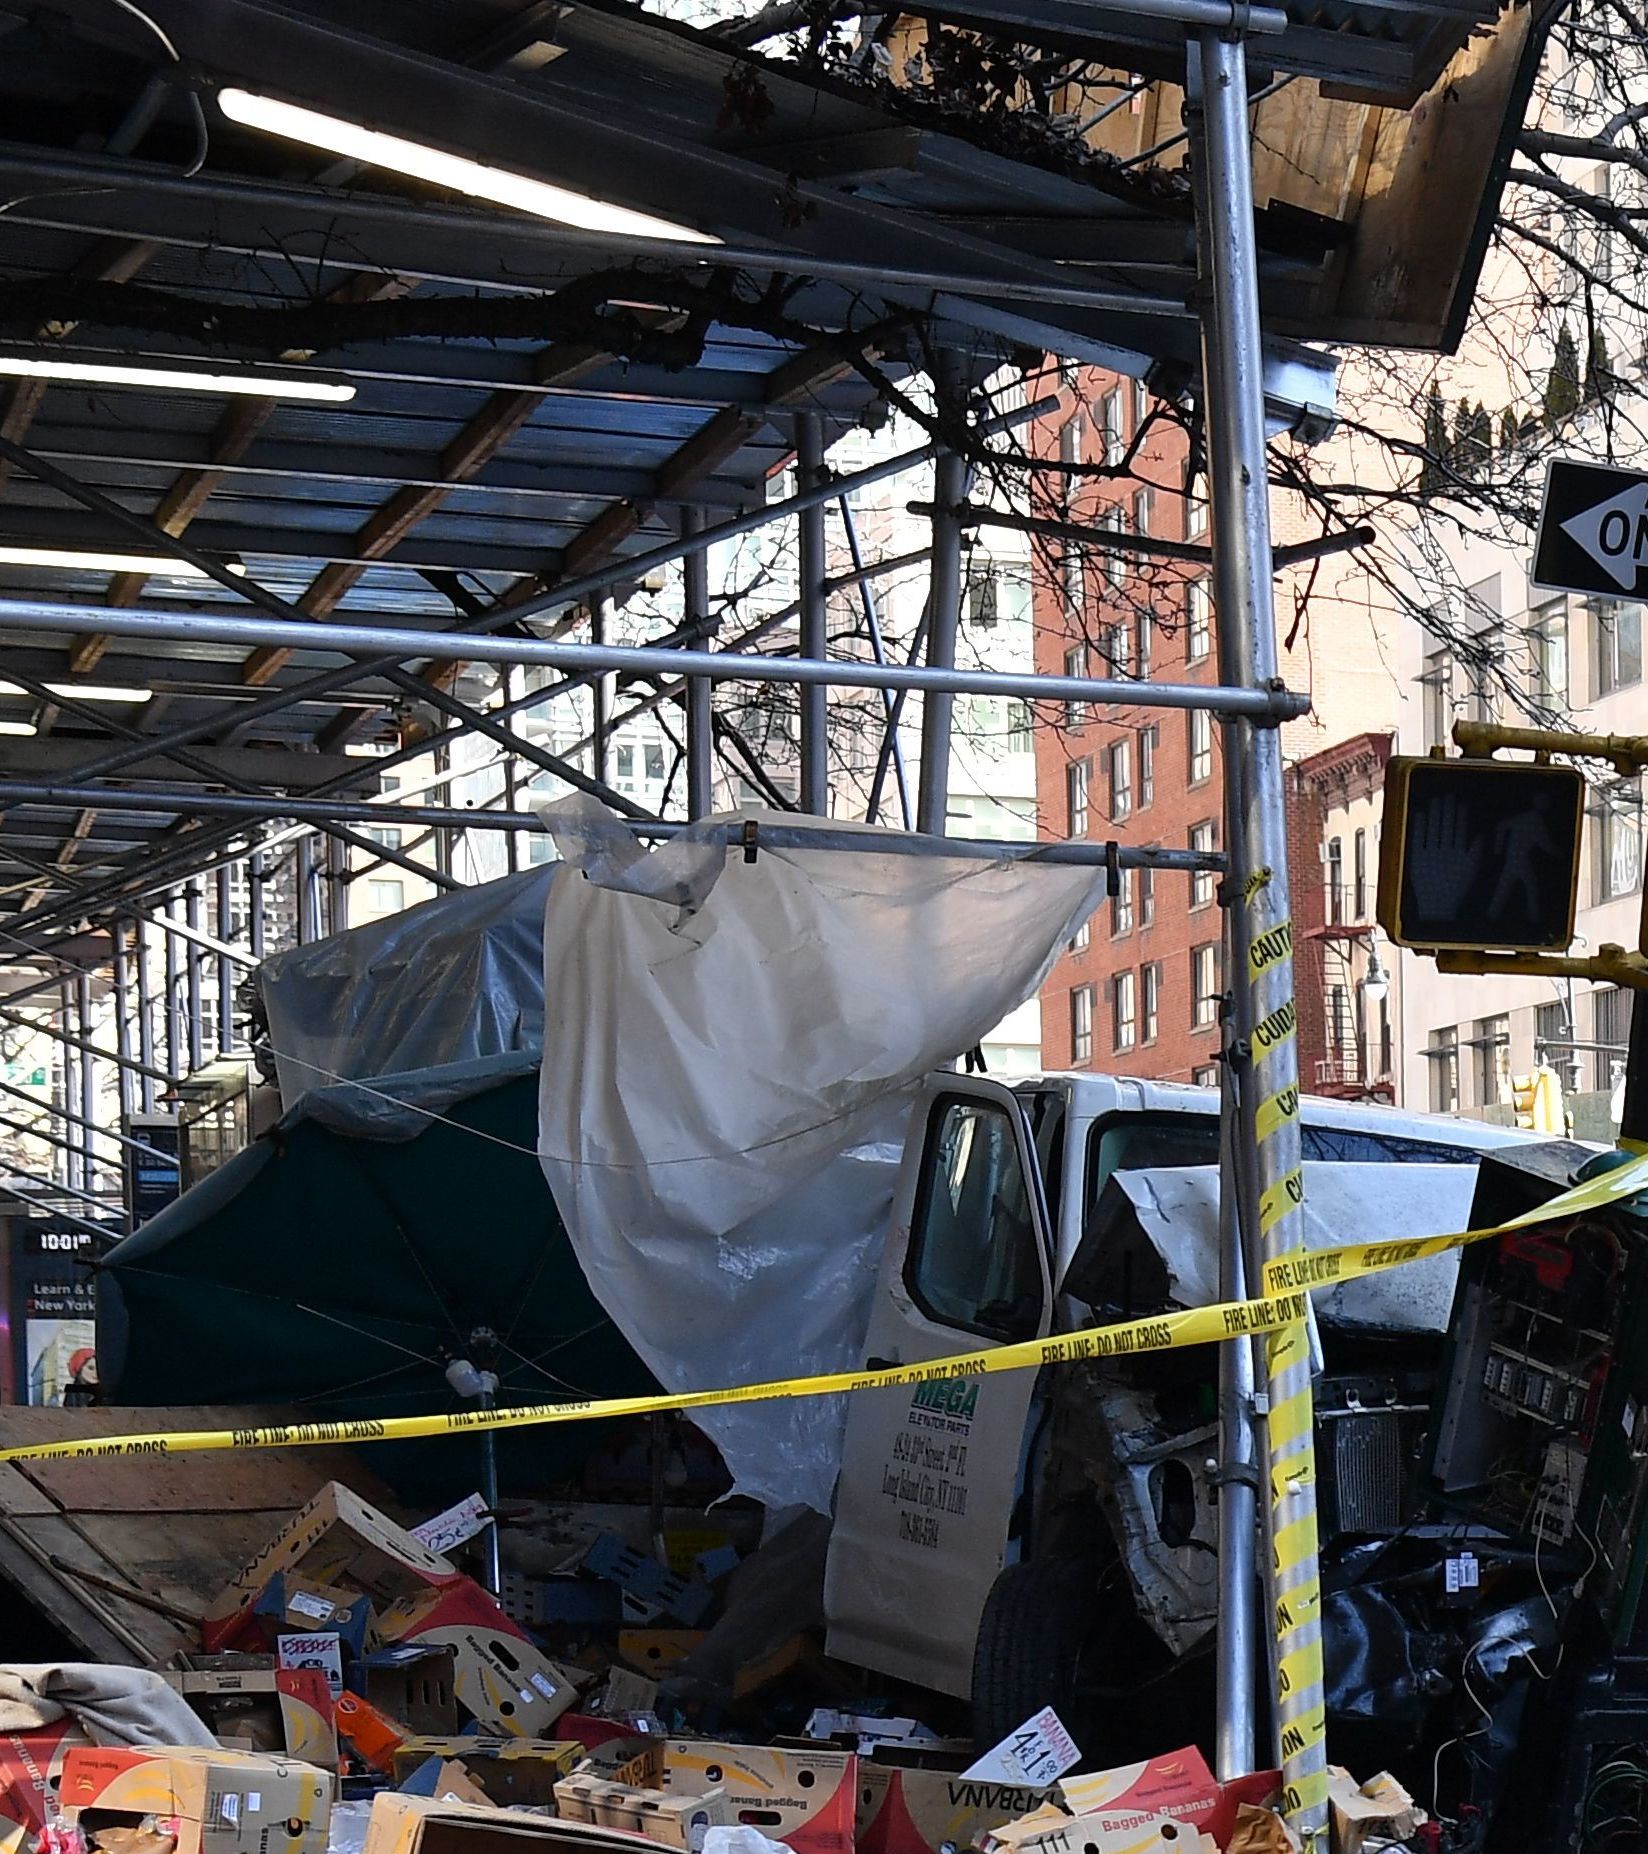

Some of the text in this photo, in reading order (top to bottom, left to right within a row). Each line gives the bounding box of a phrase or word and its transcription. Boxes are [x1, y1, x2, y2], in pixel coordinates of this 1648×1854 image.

[34, 1284, 85, 1296] Learn &
[34, 1298, 96, 1312] New York
[1223, 1308, 1246, 1334] FIRE
[1277, 1298, 1293, 1322] DO
[1041, 1344, 1066, 1365] FIRE
[1097, 1335, 1113, 1356] DO
[1114, 1331, 1136, 1353] NOT
[1137, 1322, 1173, 1350] CROSS
[911, 1378, 980, 1420] MEGA
[494, 1664, 523, 1693] Banana
[1037, 1711, 1079, 1767] BANANA
[1101, 1796, 1217, 1833] Bagged Bananas
